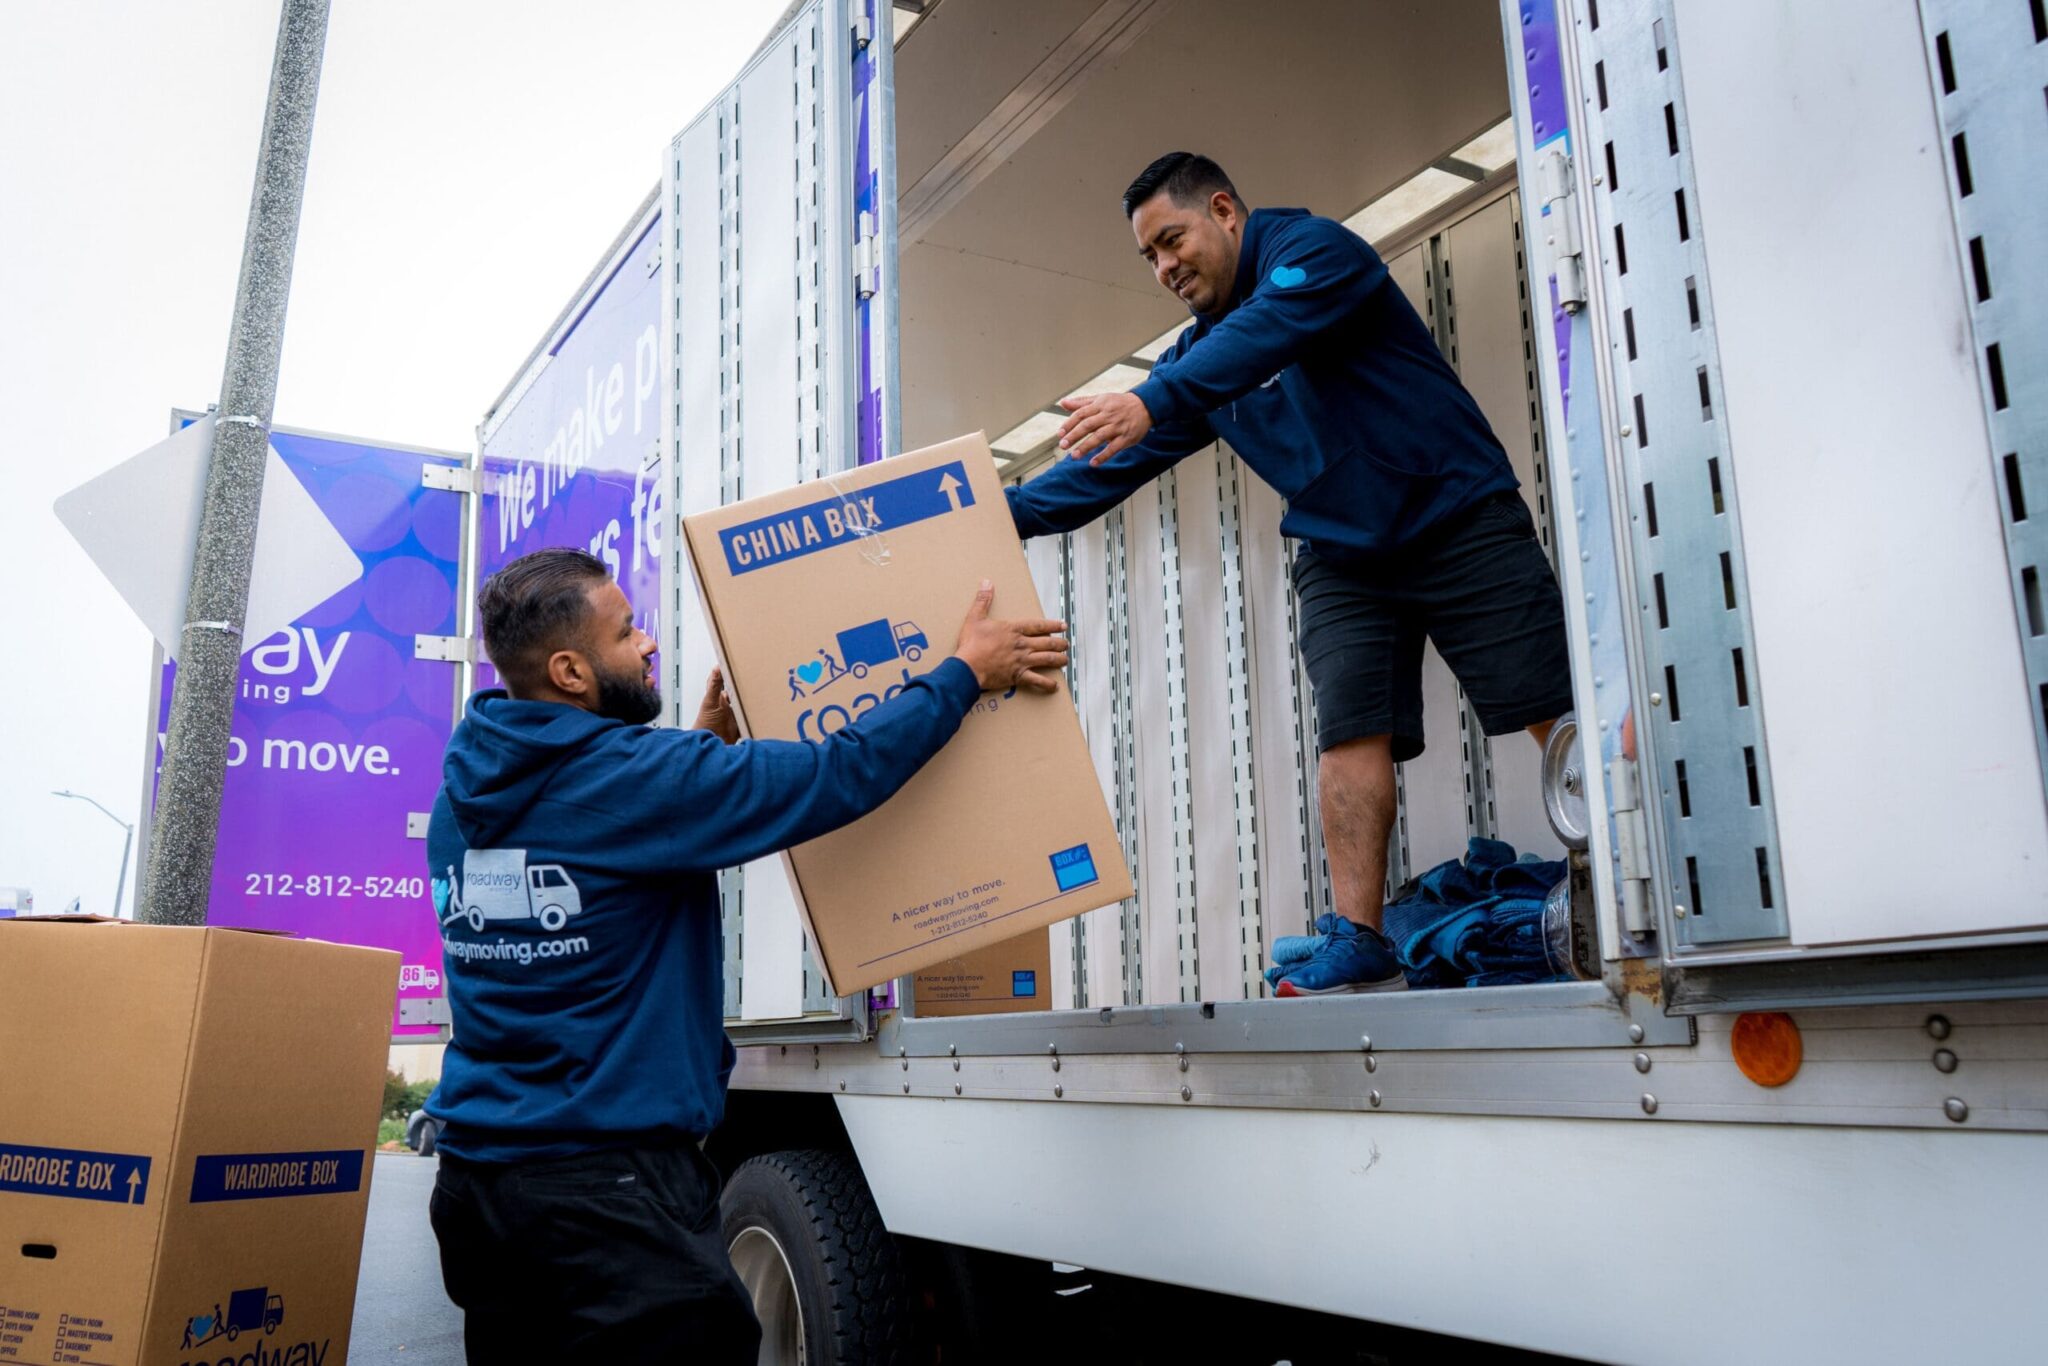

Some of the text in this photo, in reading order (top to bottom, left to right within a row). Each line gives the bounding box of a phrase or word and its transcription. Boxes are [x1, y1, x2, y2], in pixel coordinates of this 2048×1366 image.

[498, 460, 536, 554] We
[542, 364, 625, 511] make
[732, 496, 883, 566] CHINA BOX
[262, 738, 401, 776] move.
[245, 873, 424, 899] 212-812-5240
[466, 871, 522, 891] roadway
[892, 879, 1006, 922] A nicer way to move.
[913, 895, 1000, 930] roadwaymoving.com
[403, 967, 420, 982] 86
[76, 1164, 115, 1191] BOX
[224, 1160, 339, 1191] WARDROBE BOX
